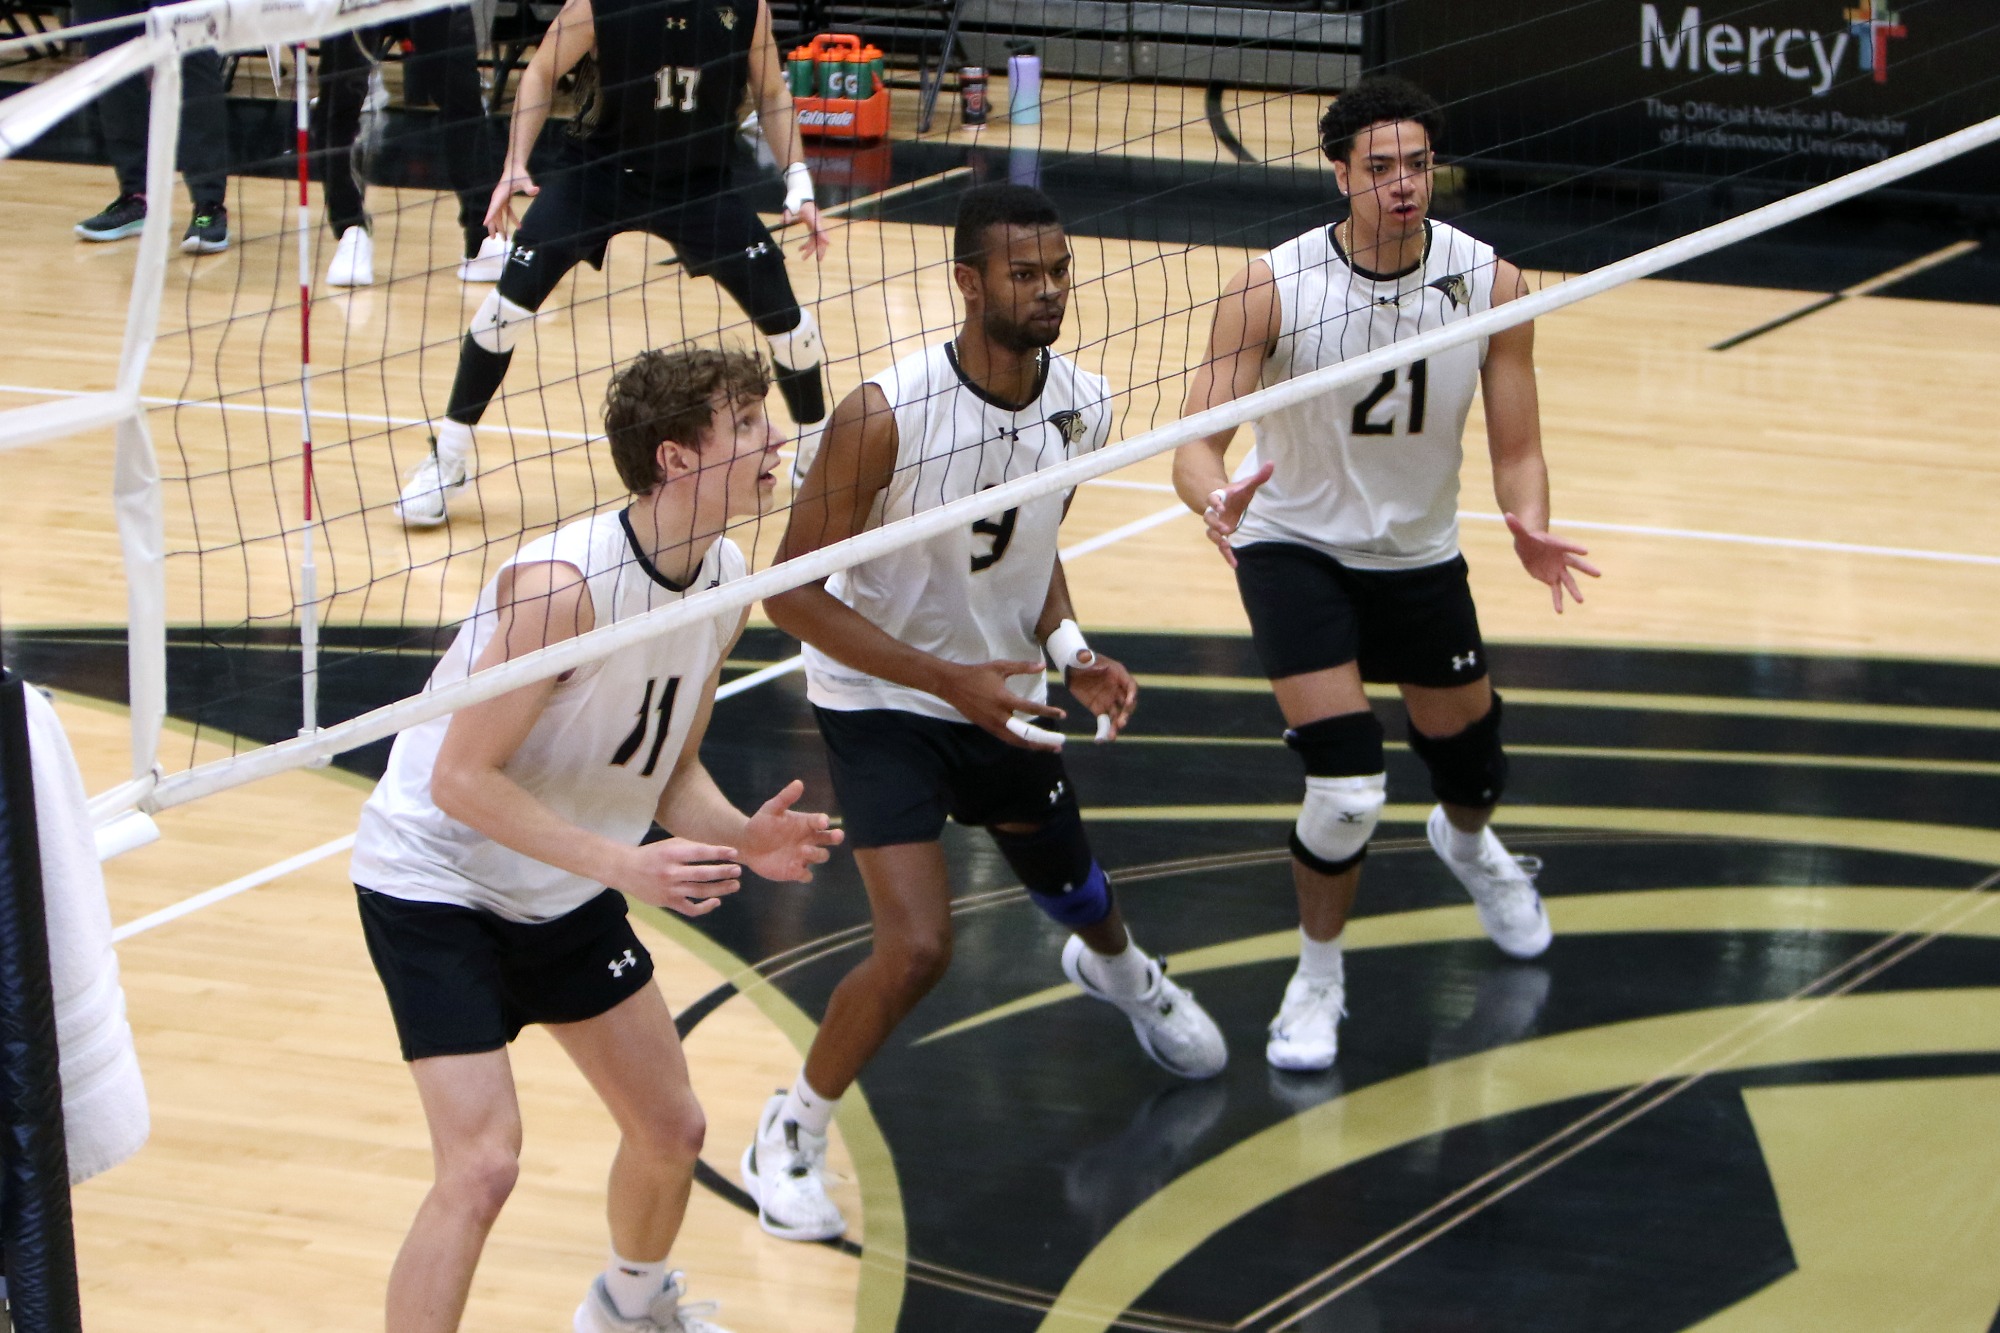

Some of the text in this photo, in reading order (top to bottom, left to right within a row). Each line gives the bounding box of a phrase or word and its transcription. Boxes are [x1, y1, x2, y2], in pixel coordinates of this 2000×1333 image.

[1640, 3, 1848, 97] Mercy
[654, 65, 699, 113] 17
[797, 109, 855, 126] Gatorade
[1646, 99, 1908, 136] The Official Medical Provider
[1660, 124, 1889, 159] of Lindenwood University
[1352, 357, 1427, 436] 21
[608, 675, 685, 778] 11
